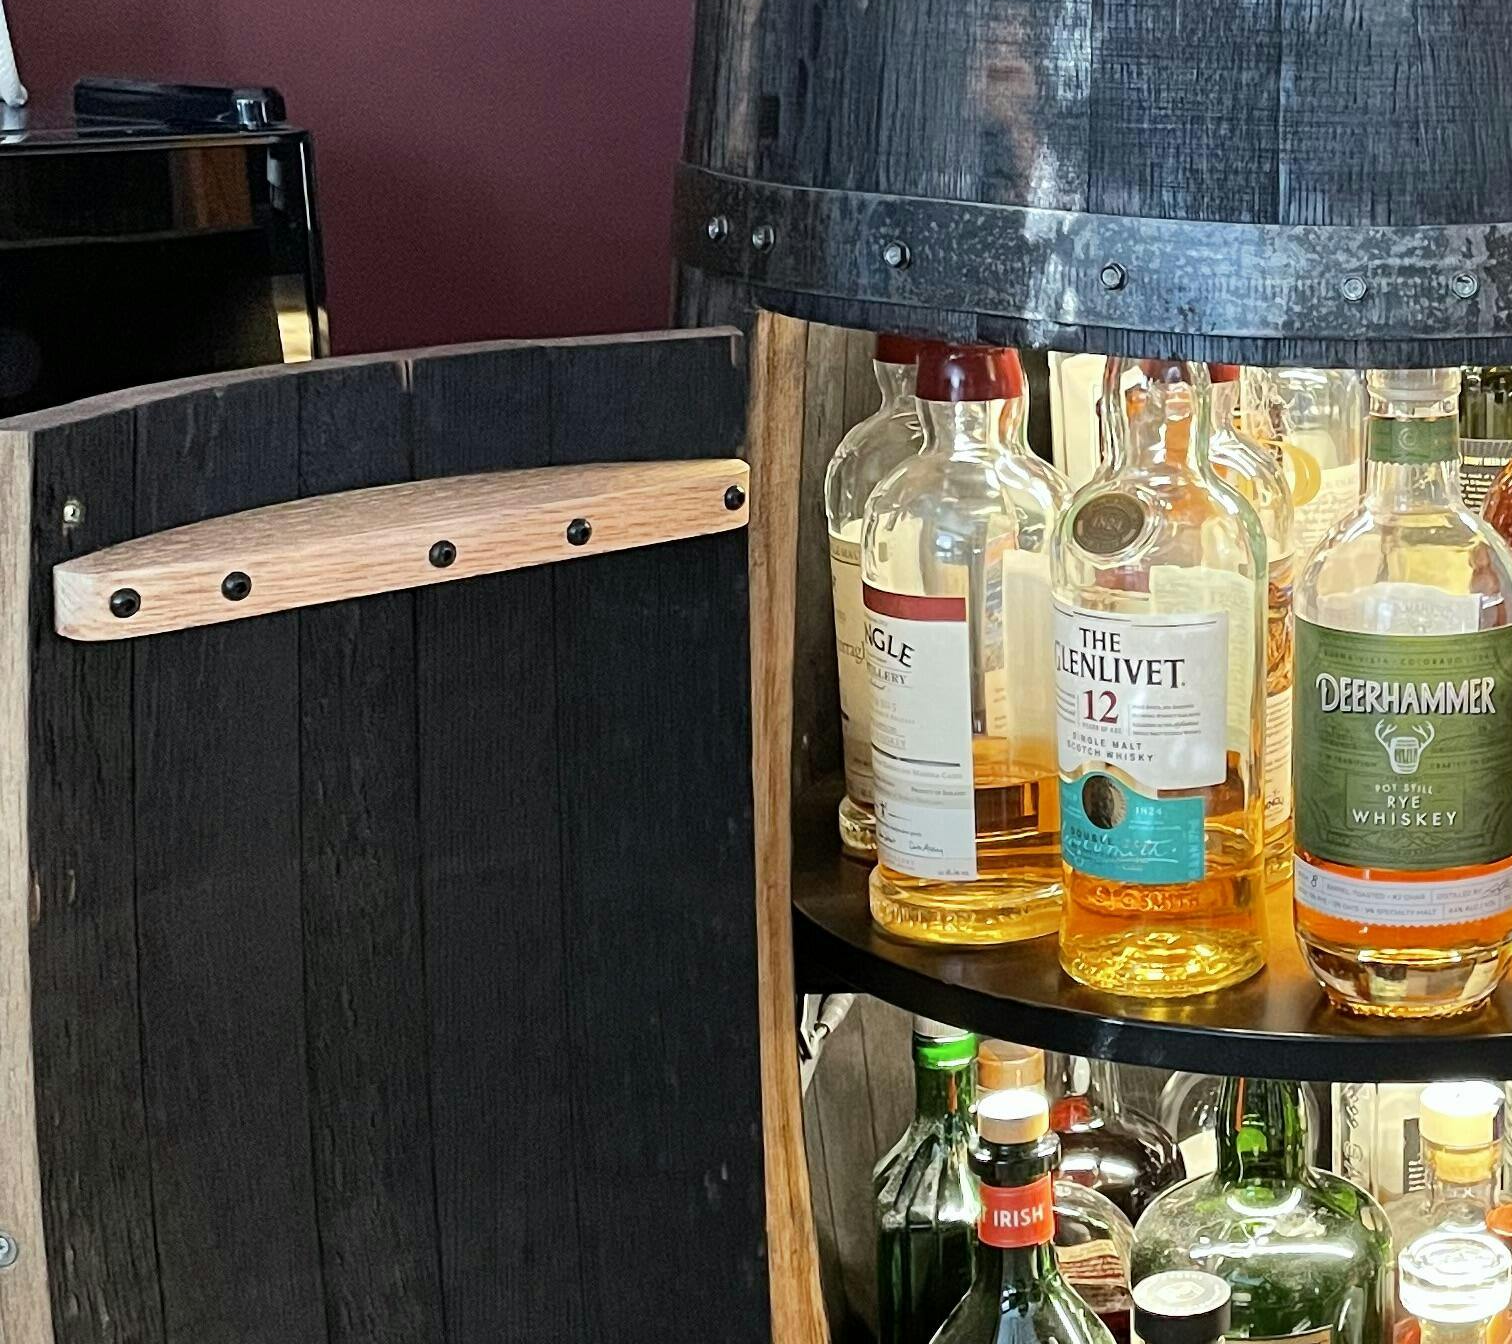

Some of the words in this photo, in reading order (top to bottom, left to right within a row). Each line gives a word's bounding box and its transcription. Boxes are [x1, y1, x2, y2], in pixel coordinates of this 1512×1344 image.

[864, 622, 915, 668] NGLE
[1079, 627, 1121, 653] THE
[1315, 672, 1496, 714] DEERHAMMER
[1082, 689, 1119, 724] 12
[1106, 751, 1154, 762] WHISKY
[1112, 740, 1142, 750] MALT
[1387, 795, 1420, 809] RYE
[1352, 809, 1457, 827] WHISKEY
[993, 1204, 1044, 1228] IRISH
